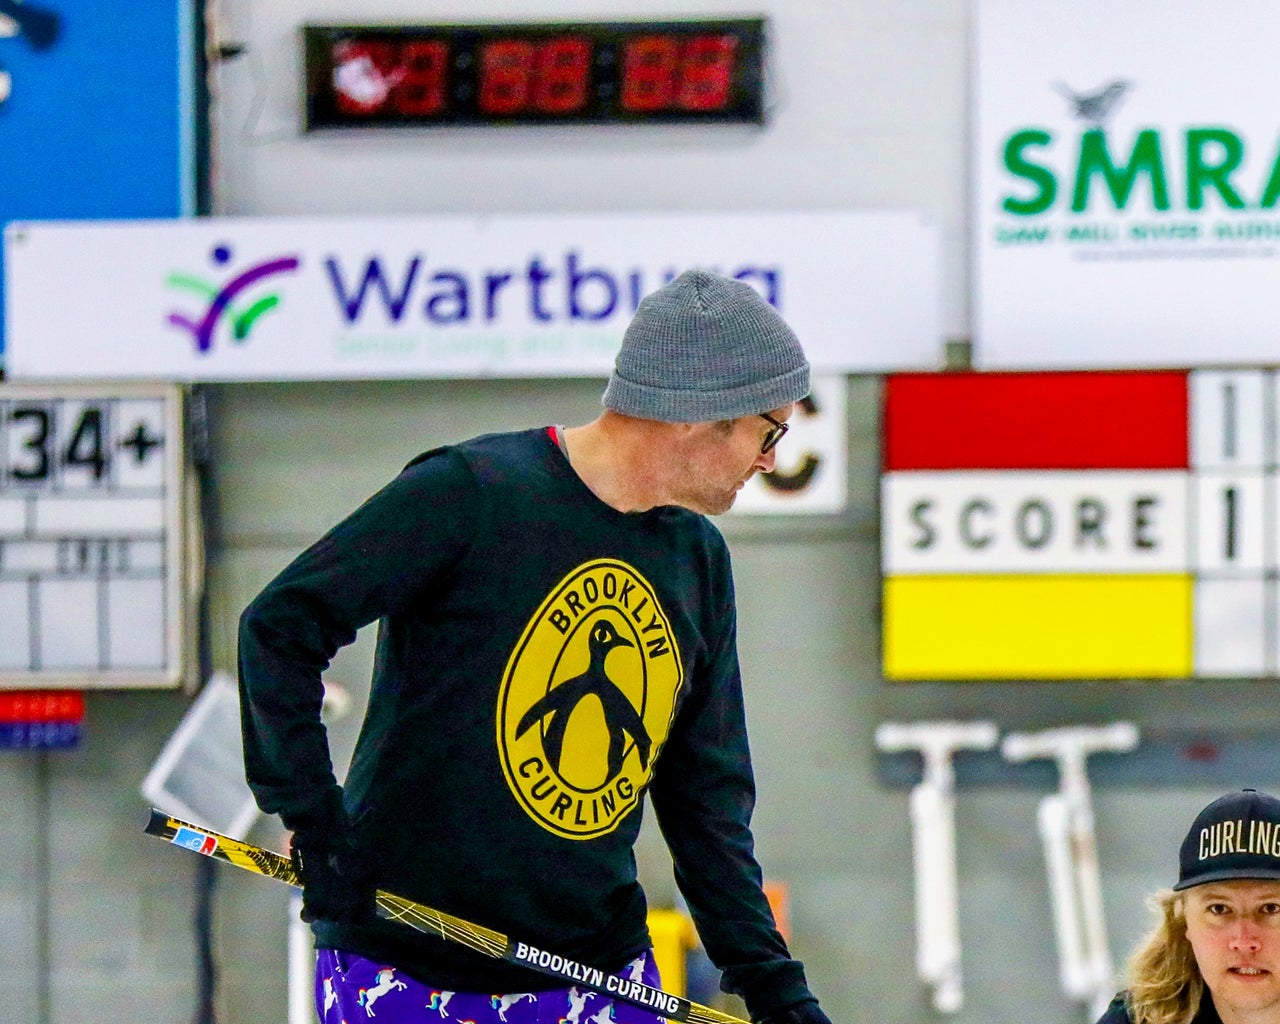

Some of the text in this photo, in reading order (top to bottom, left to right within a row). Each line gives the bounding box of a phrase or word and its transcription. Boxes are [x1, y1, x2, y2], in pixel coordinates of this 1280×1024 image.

[323, 250, 786, 325] Wartb
[908, 496, 1162, 551] SCORE
[1224, 487, 1236, 558] 1
[548, 572, 669, 660] BROOKLYN
[518, 757, 634, 826] CURLING
[515, 942, 680, 1014] BROOKLYN CURLING
